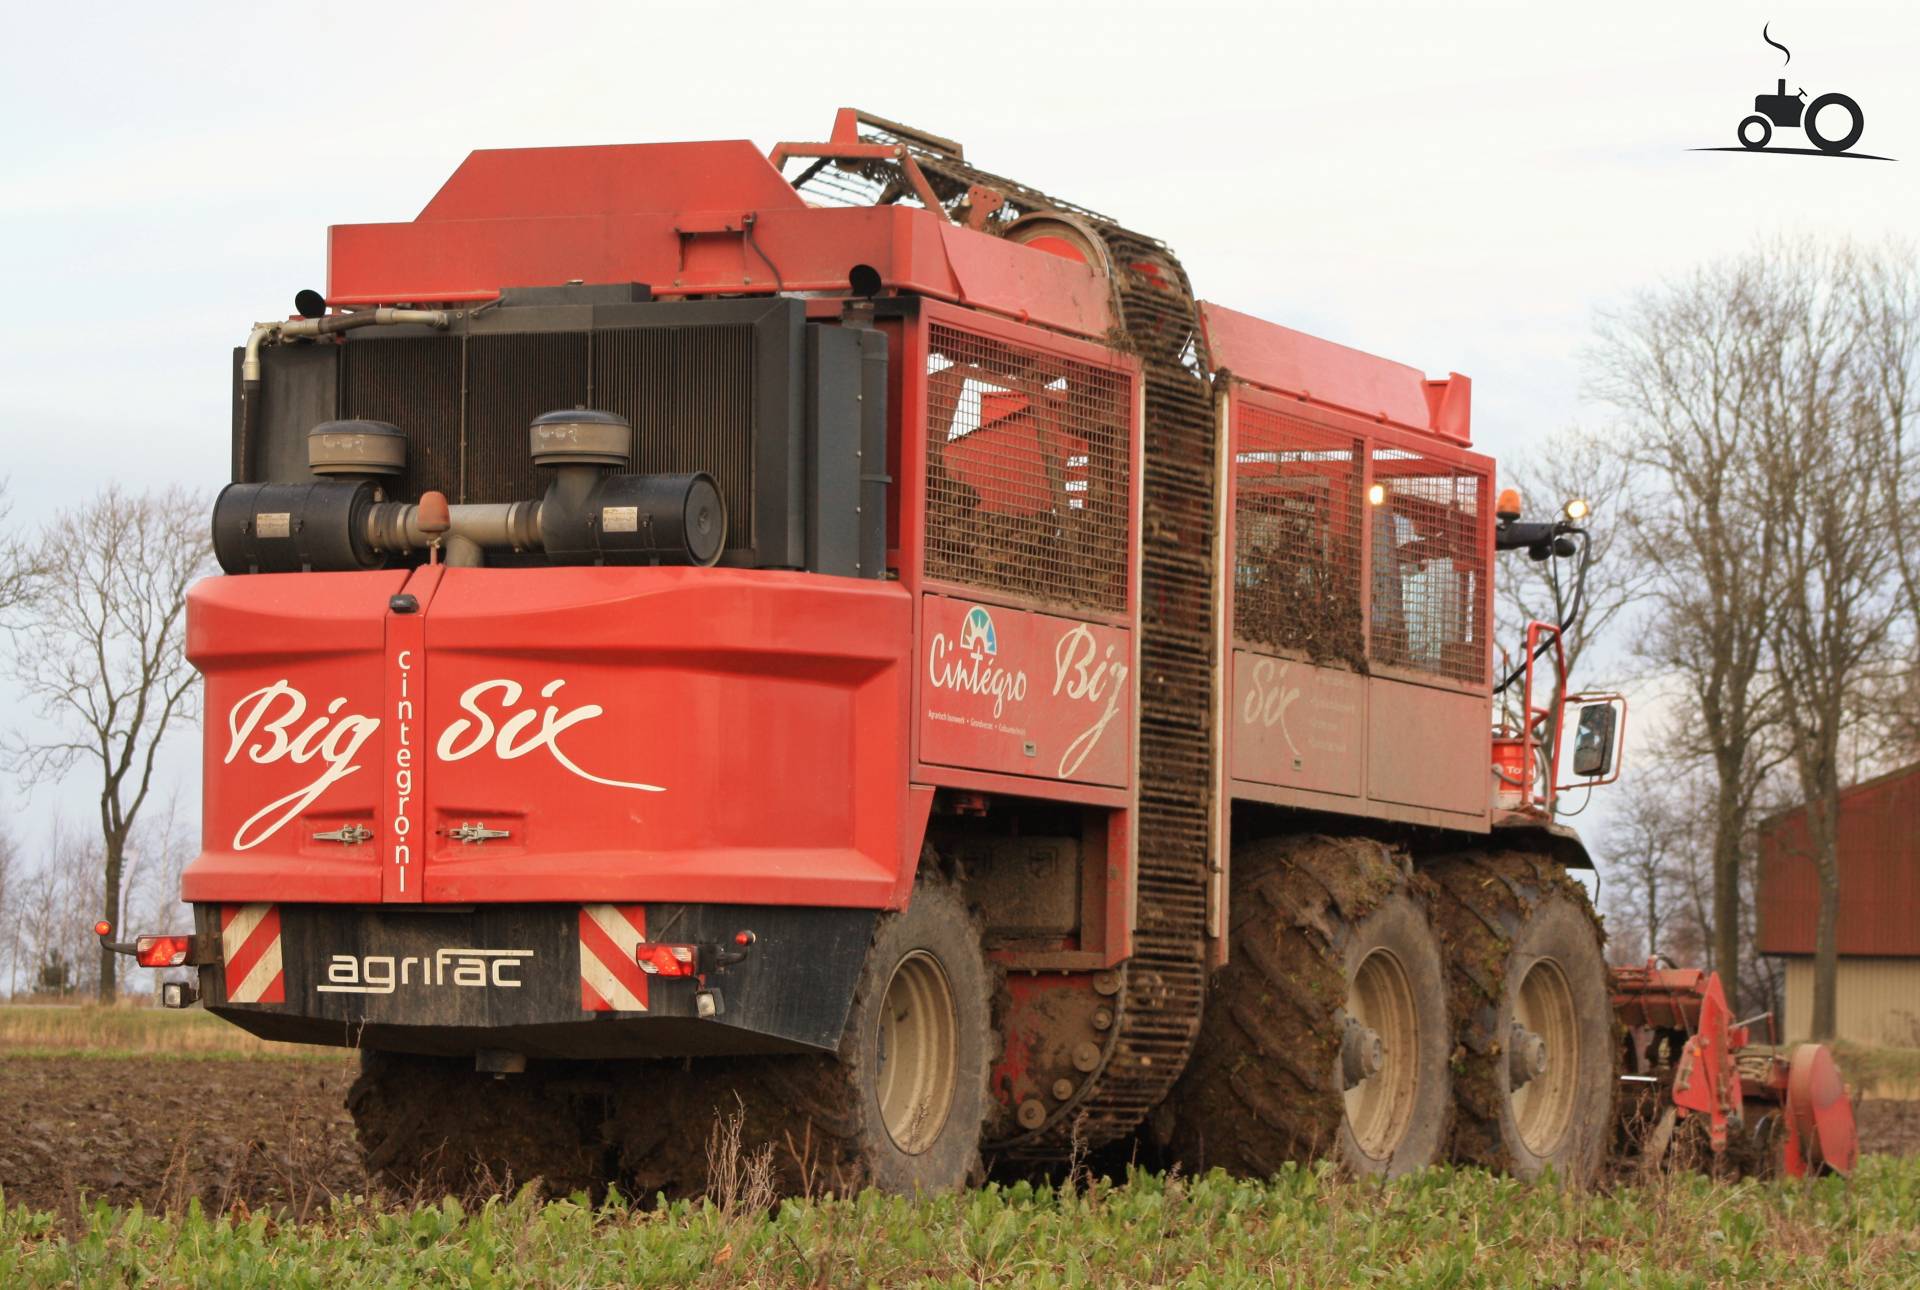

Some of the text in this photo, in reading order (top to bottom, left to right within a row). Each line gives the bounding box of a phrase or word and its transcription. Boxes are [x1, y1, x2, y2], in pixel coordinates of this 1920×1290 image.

[929, 632, 1027, 720] Cintégro
[1052, 622, 1129, 779] Big
[1243, 659, 1300, 755] Six
[223, 678, 667, 851] Big Six
[316, 948, 534, 994] agrifac
